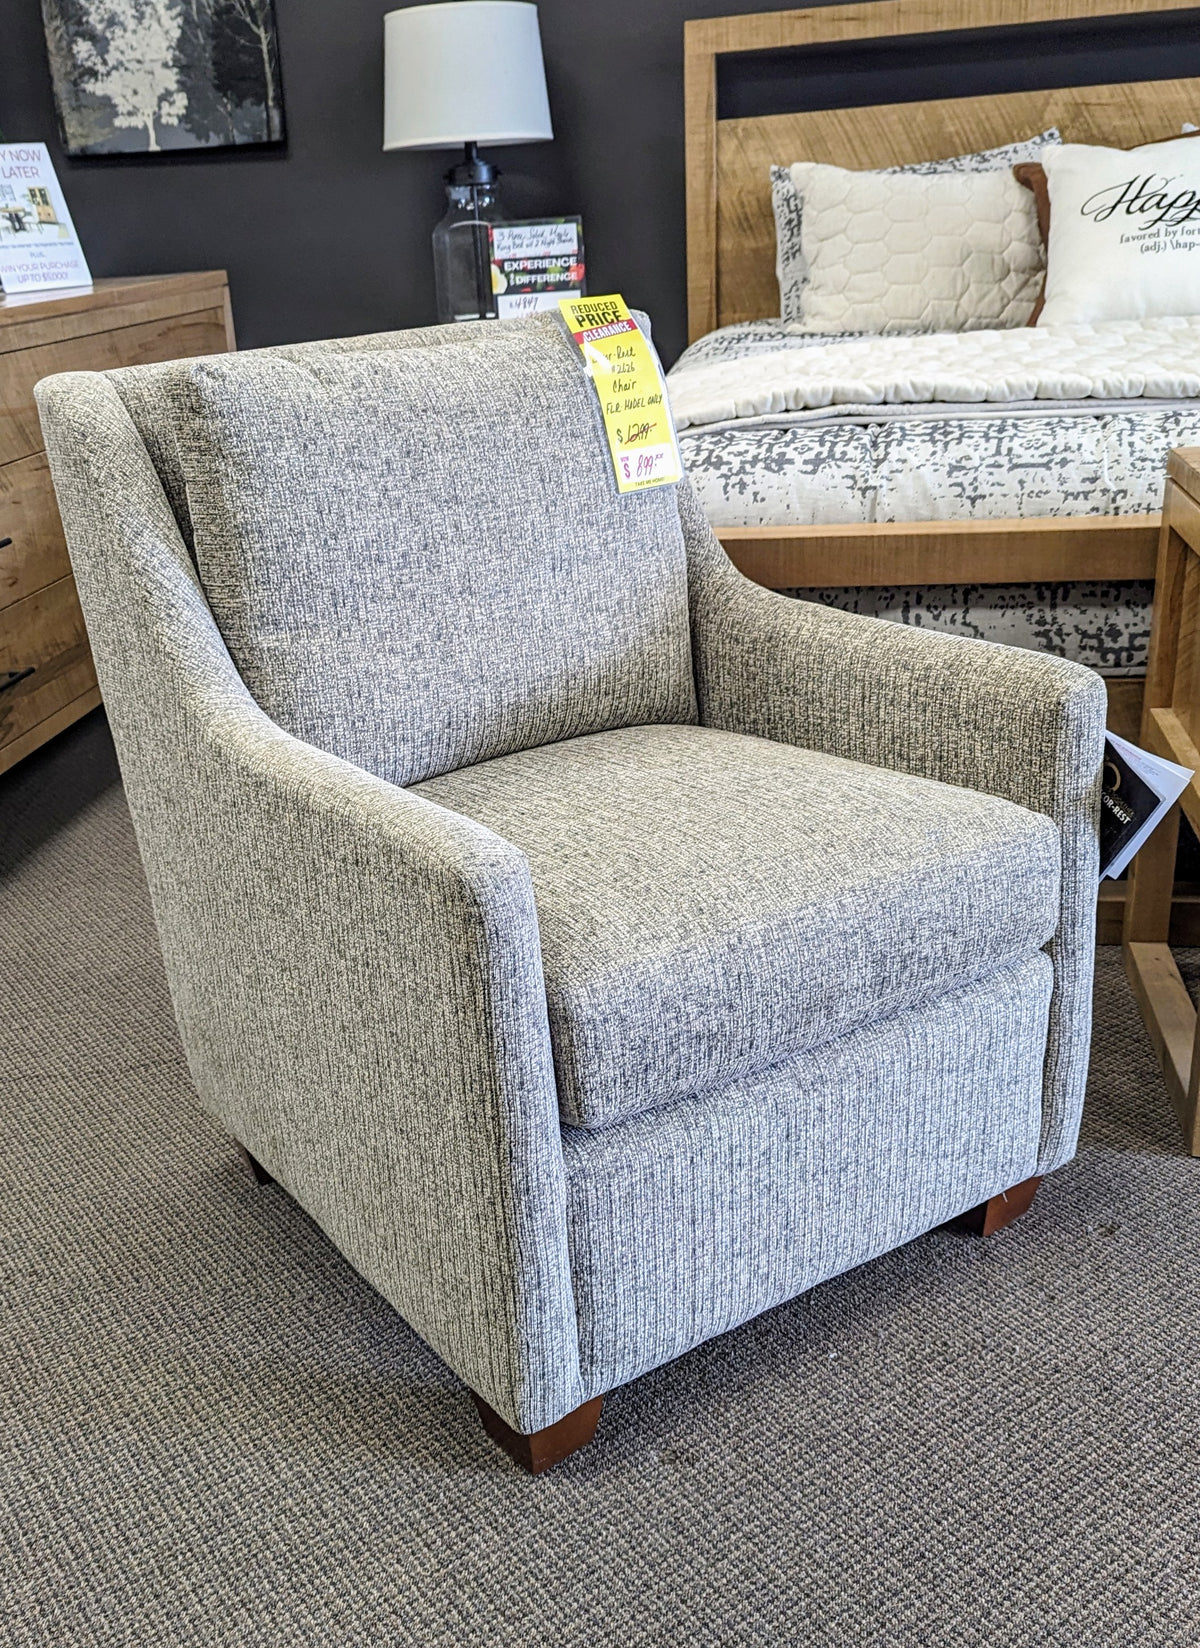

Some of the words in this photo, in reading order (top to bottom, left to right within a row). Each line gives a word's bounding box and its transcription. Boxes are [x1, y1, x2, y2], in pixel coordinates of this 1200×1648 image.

[10, 149, 41, 162] NOW
[2, 165, 40, 179] LATER
[1120, 228, 1160, 244] favored
[1164, 227, 1178, 239] by
[1140, 240, 1167, 254] (adj.)
[17, 263, 38, 272] YOUR
[40, 260, 78, 270] PURCHASE
[504, 256, 578, 271] EXPERIENCE
[17, 274, 29, 283] UP
[30, 273, 41, 282] TO
[515, 271, 578, 285] DIFFERENCE
[571, 301, 618, 315] REDUCED
[575, 310, 622, 328] PRICE
[583, 321, 632, 342] CLEARANCE
[612, 378, 637, 393] Chair
[624, 398, 646, 410] MODEL
[616, 428, 624, 443] $
[623, 463, 631, 478] $
